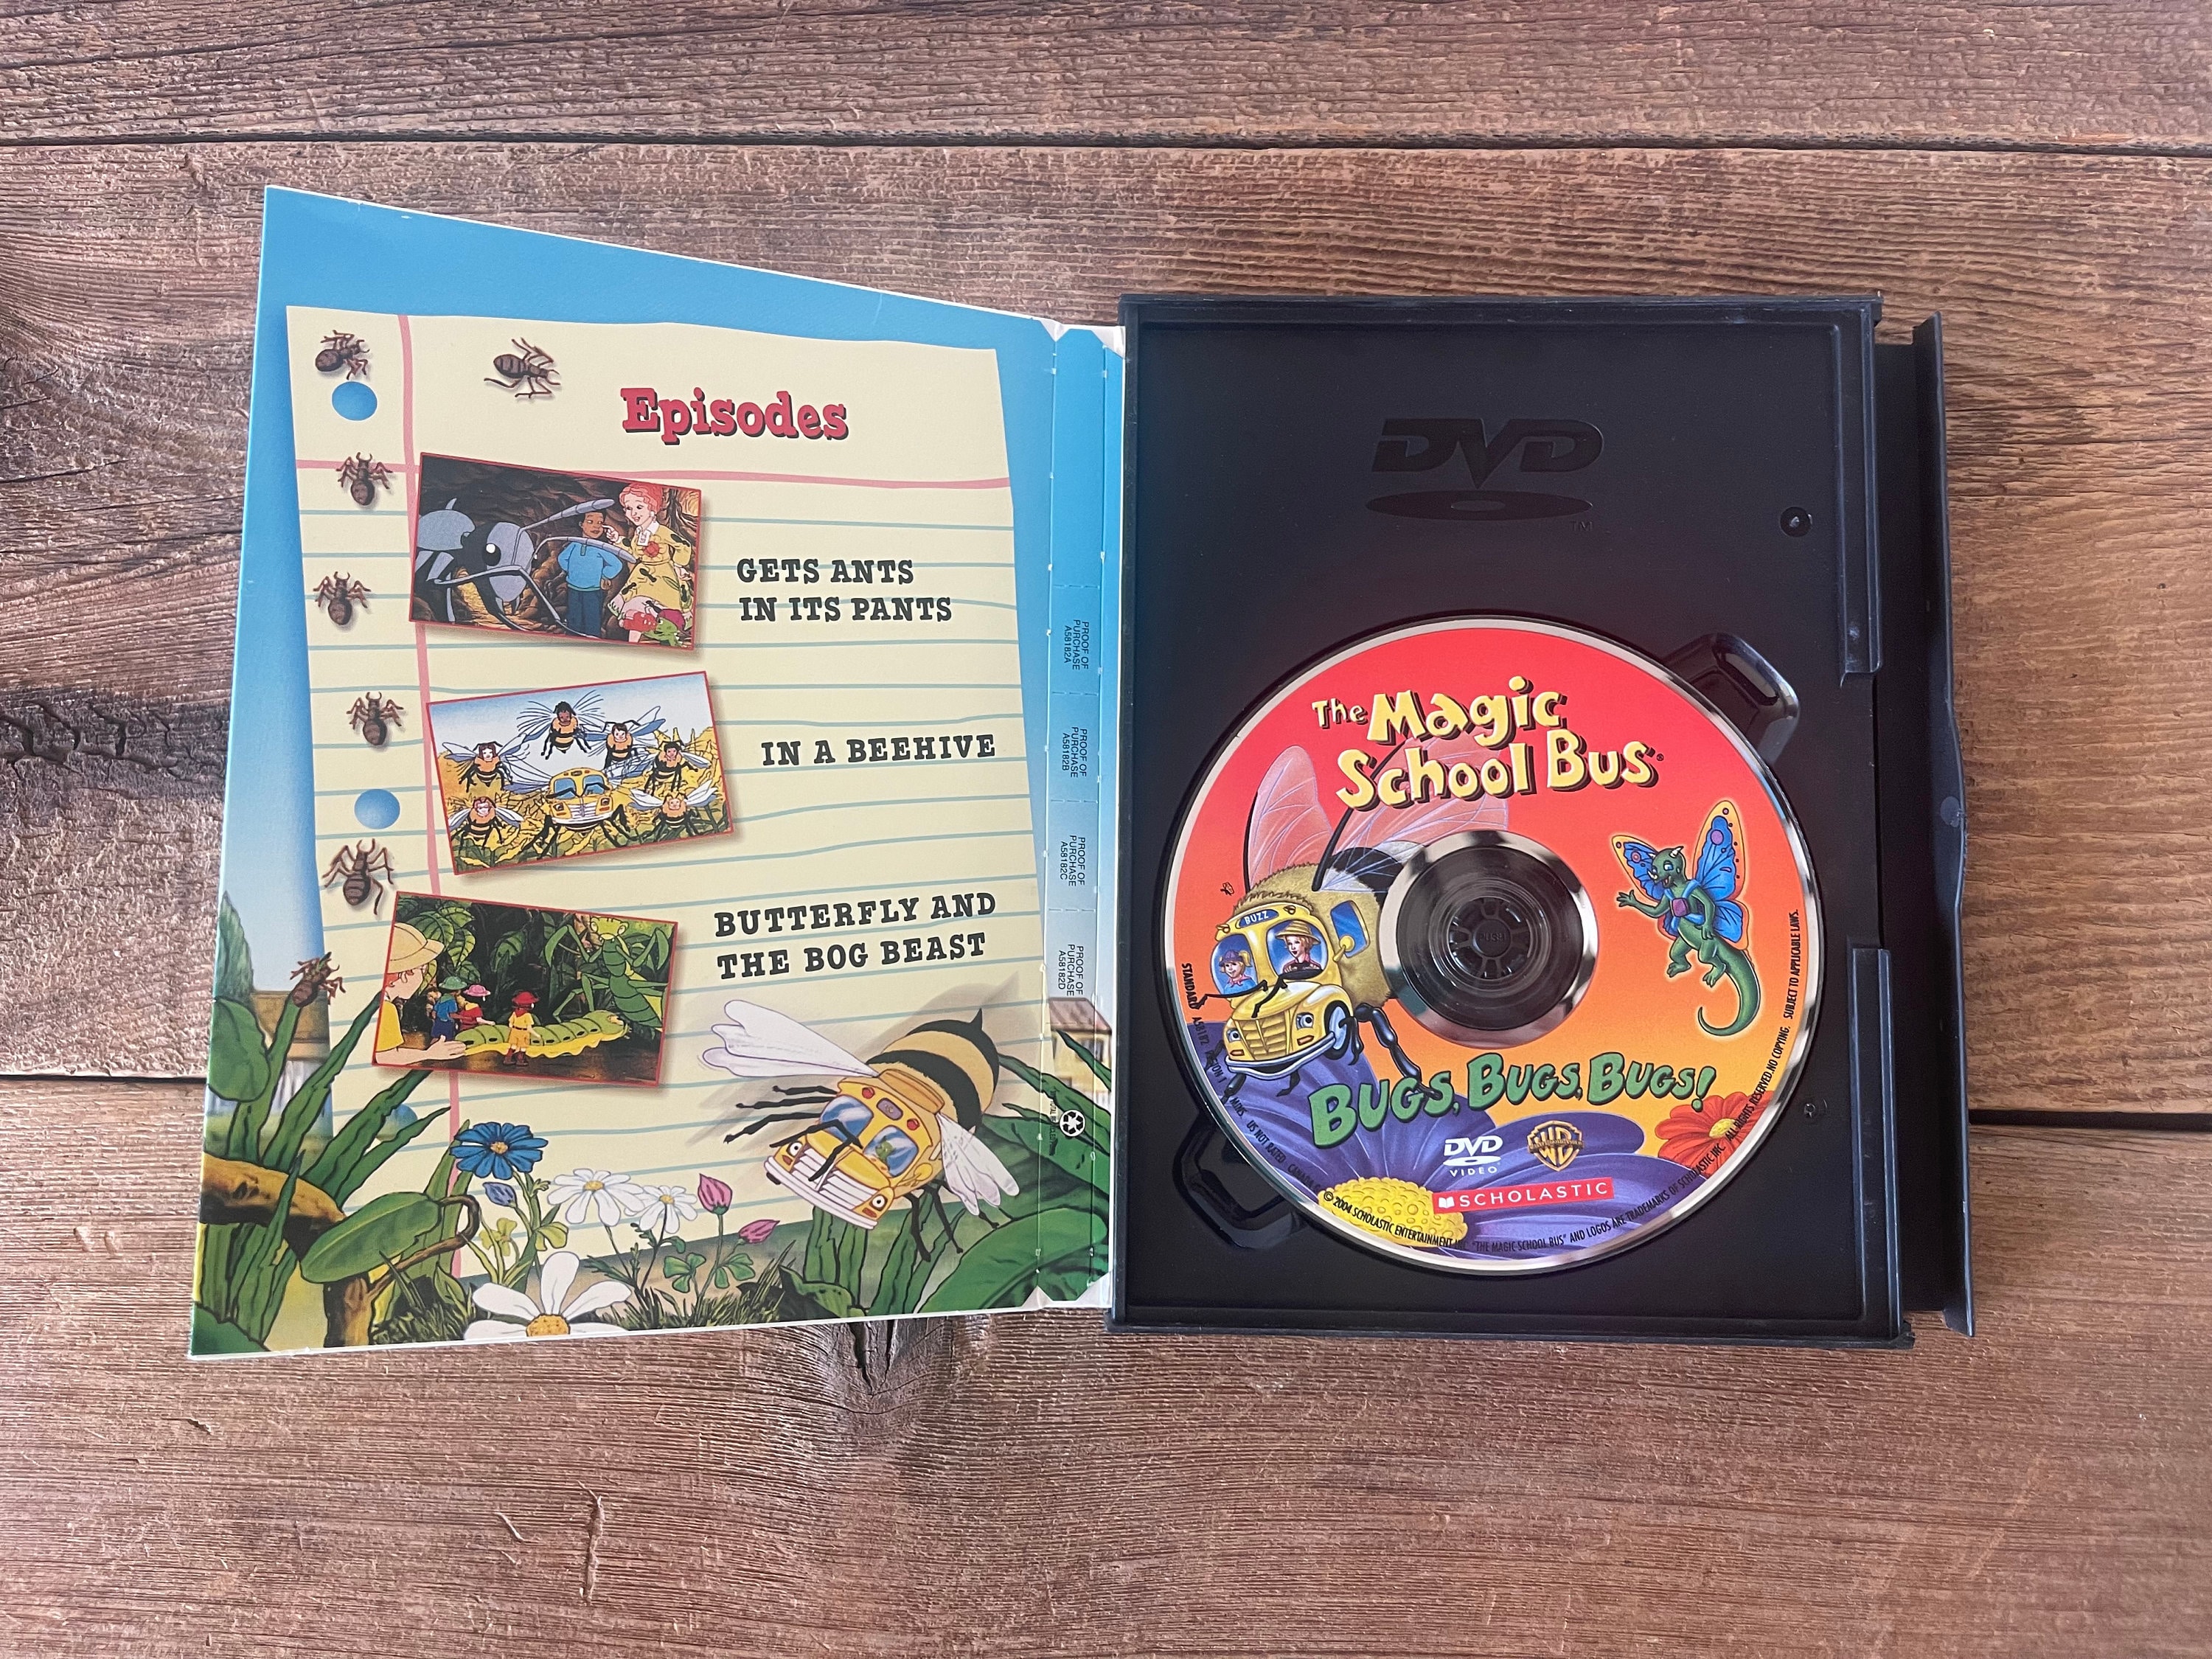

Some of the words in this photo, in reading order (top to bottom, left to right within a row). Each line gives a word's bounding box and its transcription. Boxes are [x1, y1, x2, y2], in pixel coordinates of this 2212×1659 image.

[620, 387, 849, 445] Episodes
[1371, 418, 1604, 490] DVD
[737, 557, 820, 585] GETS
[830, 558, 914, 585] ANTS
[739, 597, 777, 622] IN
[788, 597, 841, 622] ITS
[850, 597, 953, 622] PANTS
[1064, 625, 1072, 664] A58182A
[1072, 619, 1081, 670] PURCHASE
[1081, 621, 1089, 655] PROOF
[1081, 657, 1089, 669] OF
[1312, 698, 1368, 730] The
[1366, 675, 1568, 752] Magic
[761, 740, 801, 767] IN
[813, 739, 837, 764] A
[846, 734, 997, 764] BEEHIVE
[1062, 732, 1071, 771] A58182B
[1070, 726, 1079, 778] PURCHASE
[1079, 728, 1088, 764] PROOF
[1079, 765, 1087, 777] OF
[1335, 742, 1539, 812] School
[1060, 841, 1068, 880] A58182C
[1068, 835, 1077, 887] PURCHASE
[1077, 837, 1085, 872] PROOF
[1077, 873, 1085, 886] OF
[714, 897, 919, 937] BUTTERFLY
[930, 892, 996, 919] AND
[1244, 909, 1270, 925] BUZZ
[717, 949, 790, 980] THE
[804, 942, 869, 973] BOG
[880, 931, 986, 965] BEAST
[1057, 950, 1066, 990] A58182D
[1066, 944, 1075, 996] PURCHASE
[1076, 945, 1084, 980] PROOF
[1790, 933, 1801, 976] APPLICABLE
[1075, 981, 1084, 995] OF
[1789, 977, 1799, 987] TO
[1783, 989, 1798, 1020] SUBJECT
[1308, 1074, 1461, 1149] BUGS,
[1465, 1051, 1582, 1111] BUGS,
[1587, 1051, 1717, 1113] BUGS!
[1733, 1103, 1755, 1130] RIGHTS
[1246, 1119, 1259, 1133] US
[1253, 1129, 1270, 1146] NOT
[1265, 1142, 1287, 1164] RATED
[1443, 1135, 1503, 1157] DVD
[1725, 1125, 1739, 1141] ALL
[1450, 1166, 1498, 1178] VIDEO
[1677, 1157, 1716, 1190] SCHOLASTIC
[1332, 1197, 1352, 1214] 2004
[1458, 1181, 1608, 1208] SCHOLASTIC
[1625, 1189, 1671, 1222] TRADEMARKS
[1669, 1183, 1680, 1196] OF
[1352, 1207, 1394, 1234] SCHOLASTIC
[1394, 1225, 1454, 1248] ENTERTAINMENT
[1586, 1220, 1612, 1238] LOGOS
[1612, 1215, 1627, 1229] ARE
[1491, 1240, 1515, 1253] MAGIC
[1517, 1238, 1547, 1252] SCHOOL
[1569, 1231, 1586, 1243] AND
